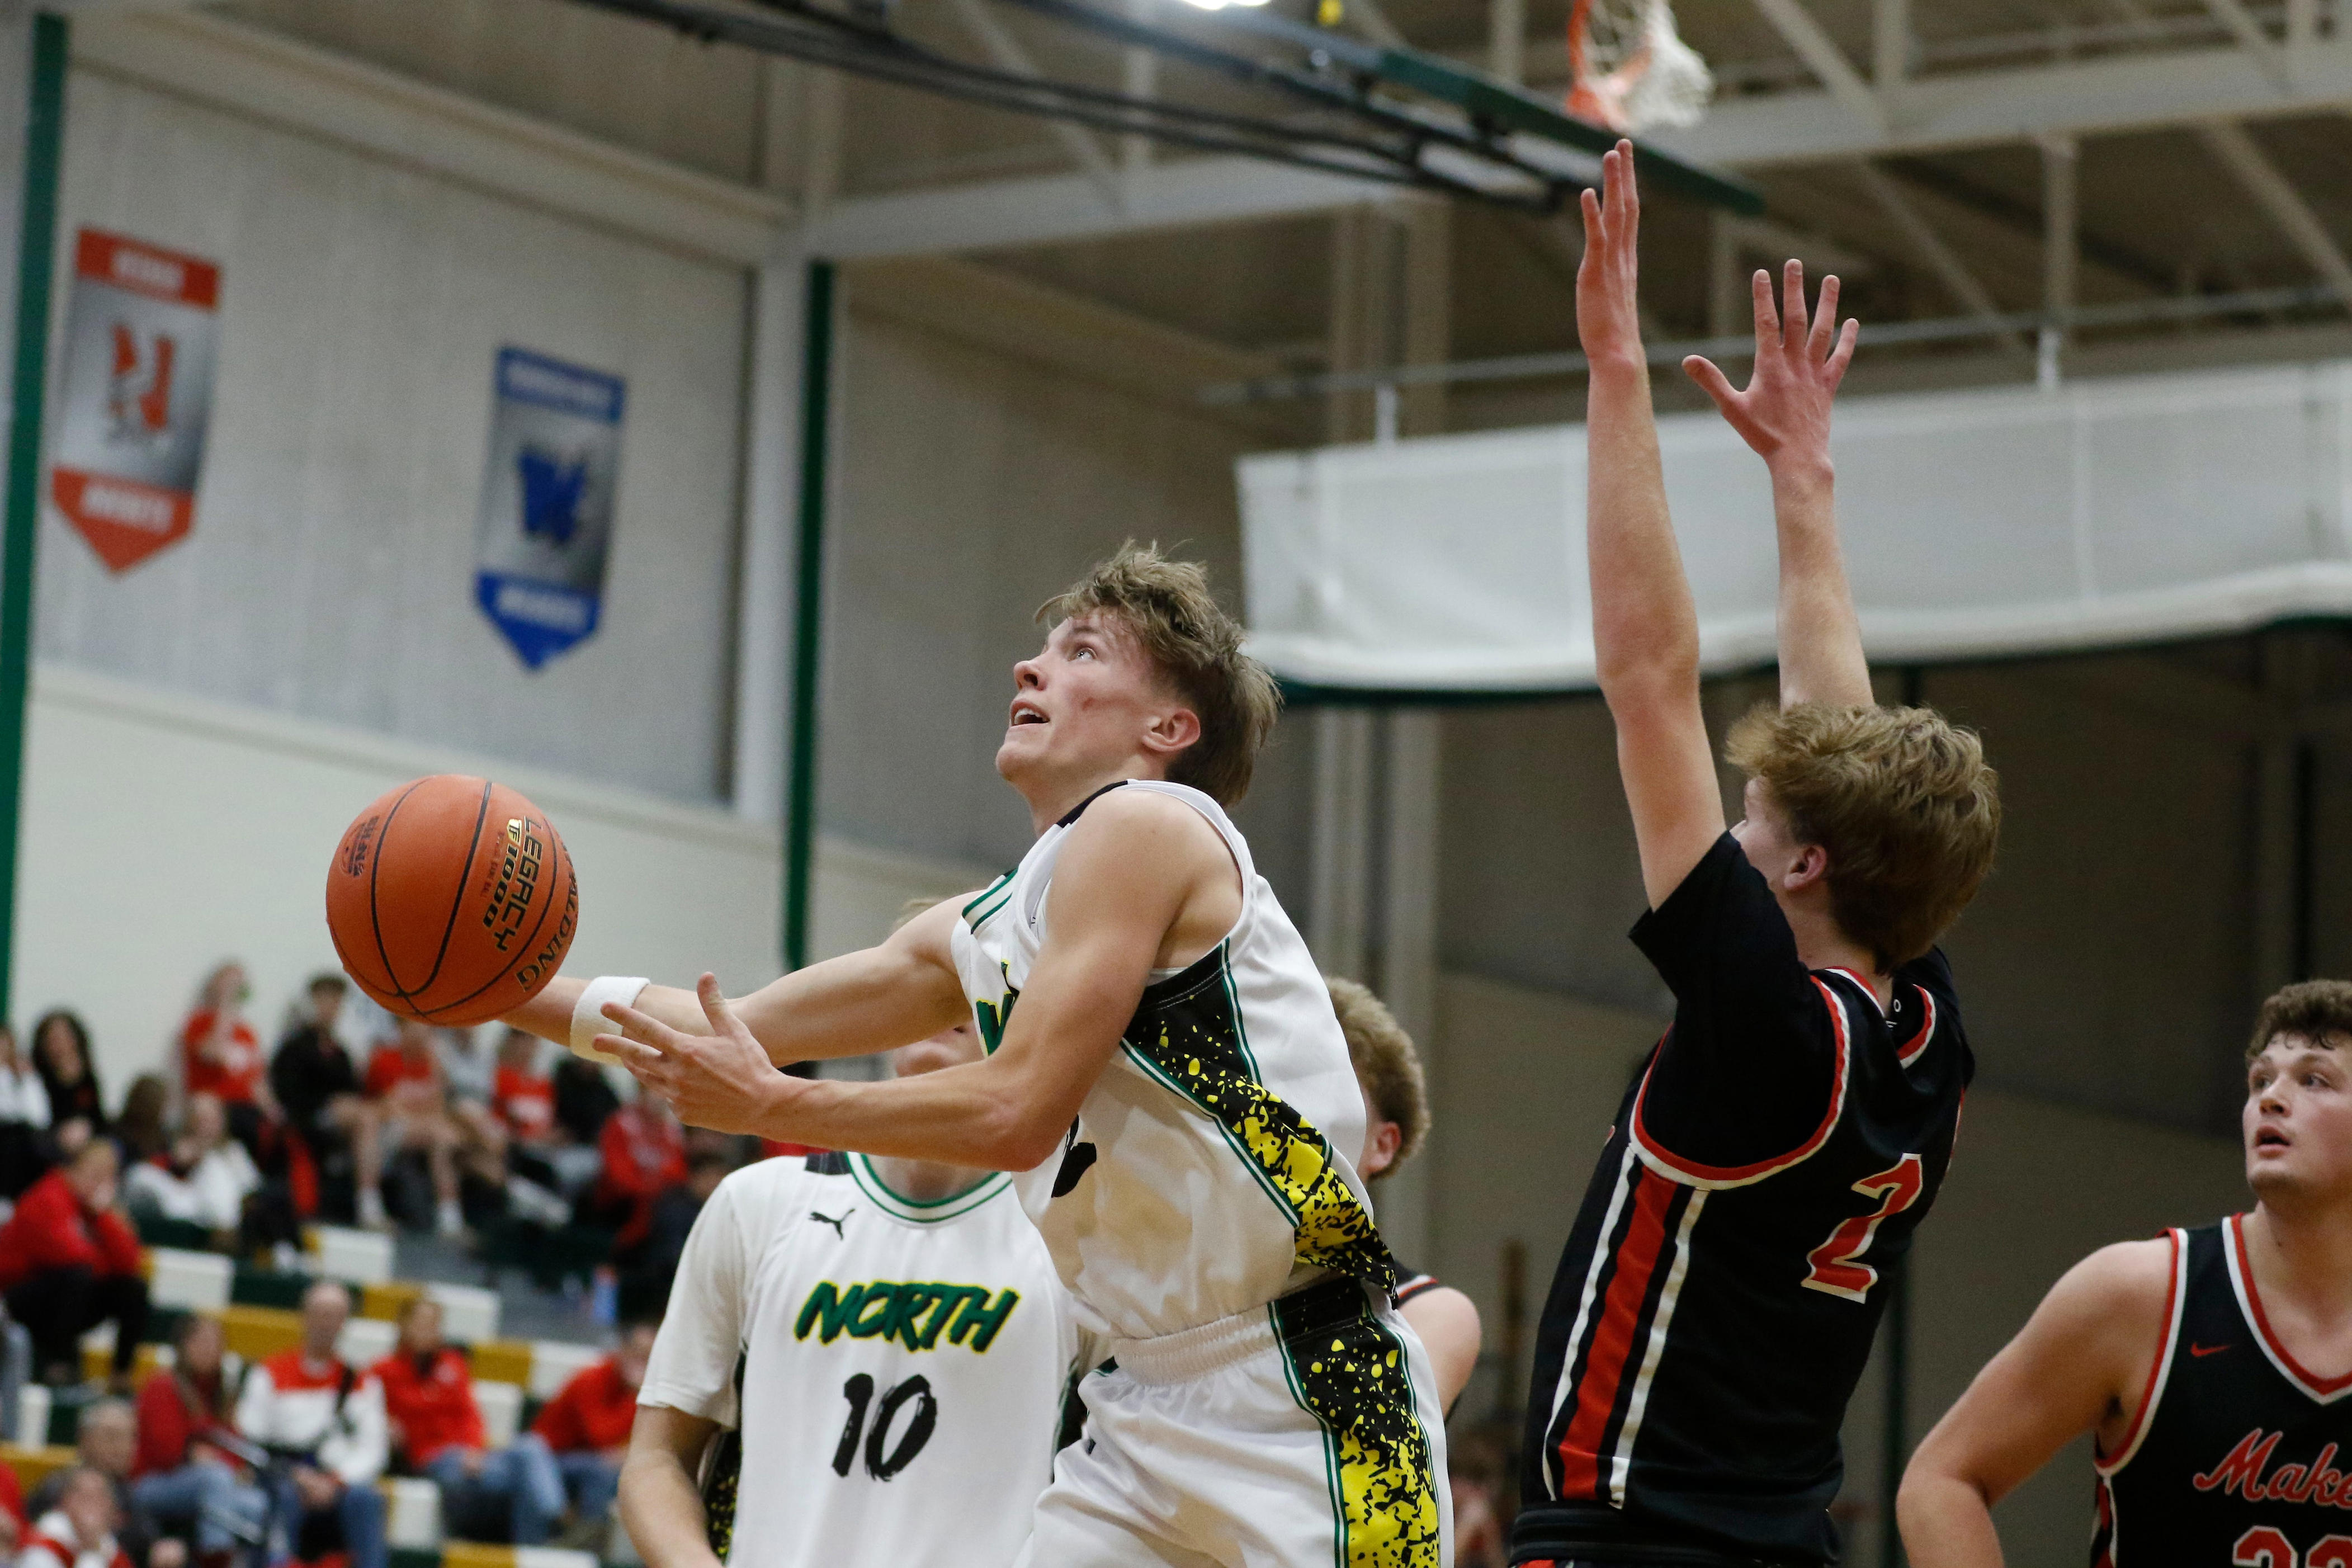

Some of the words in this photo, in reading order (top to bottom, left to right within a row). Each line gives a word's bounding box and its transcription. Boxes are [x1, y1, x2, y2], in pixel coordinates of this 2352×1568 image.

[495, 815, 543, 951] LEGACY
[515, 840, 578, 993] ALDING
[1801, 1153, 1923, 1304] 2
[794, 1280, 1021, 1354] NORTH
[832, 1373, 937, 1482] 10
